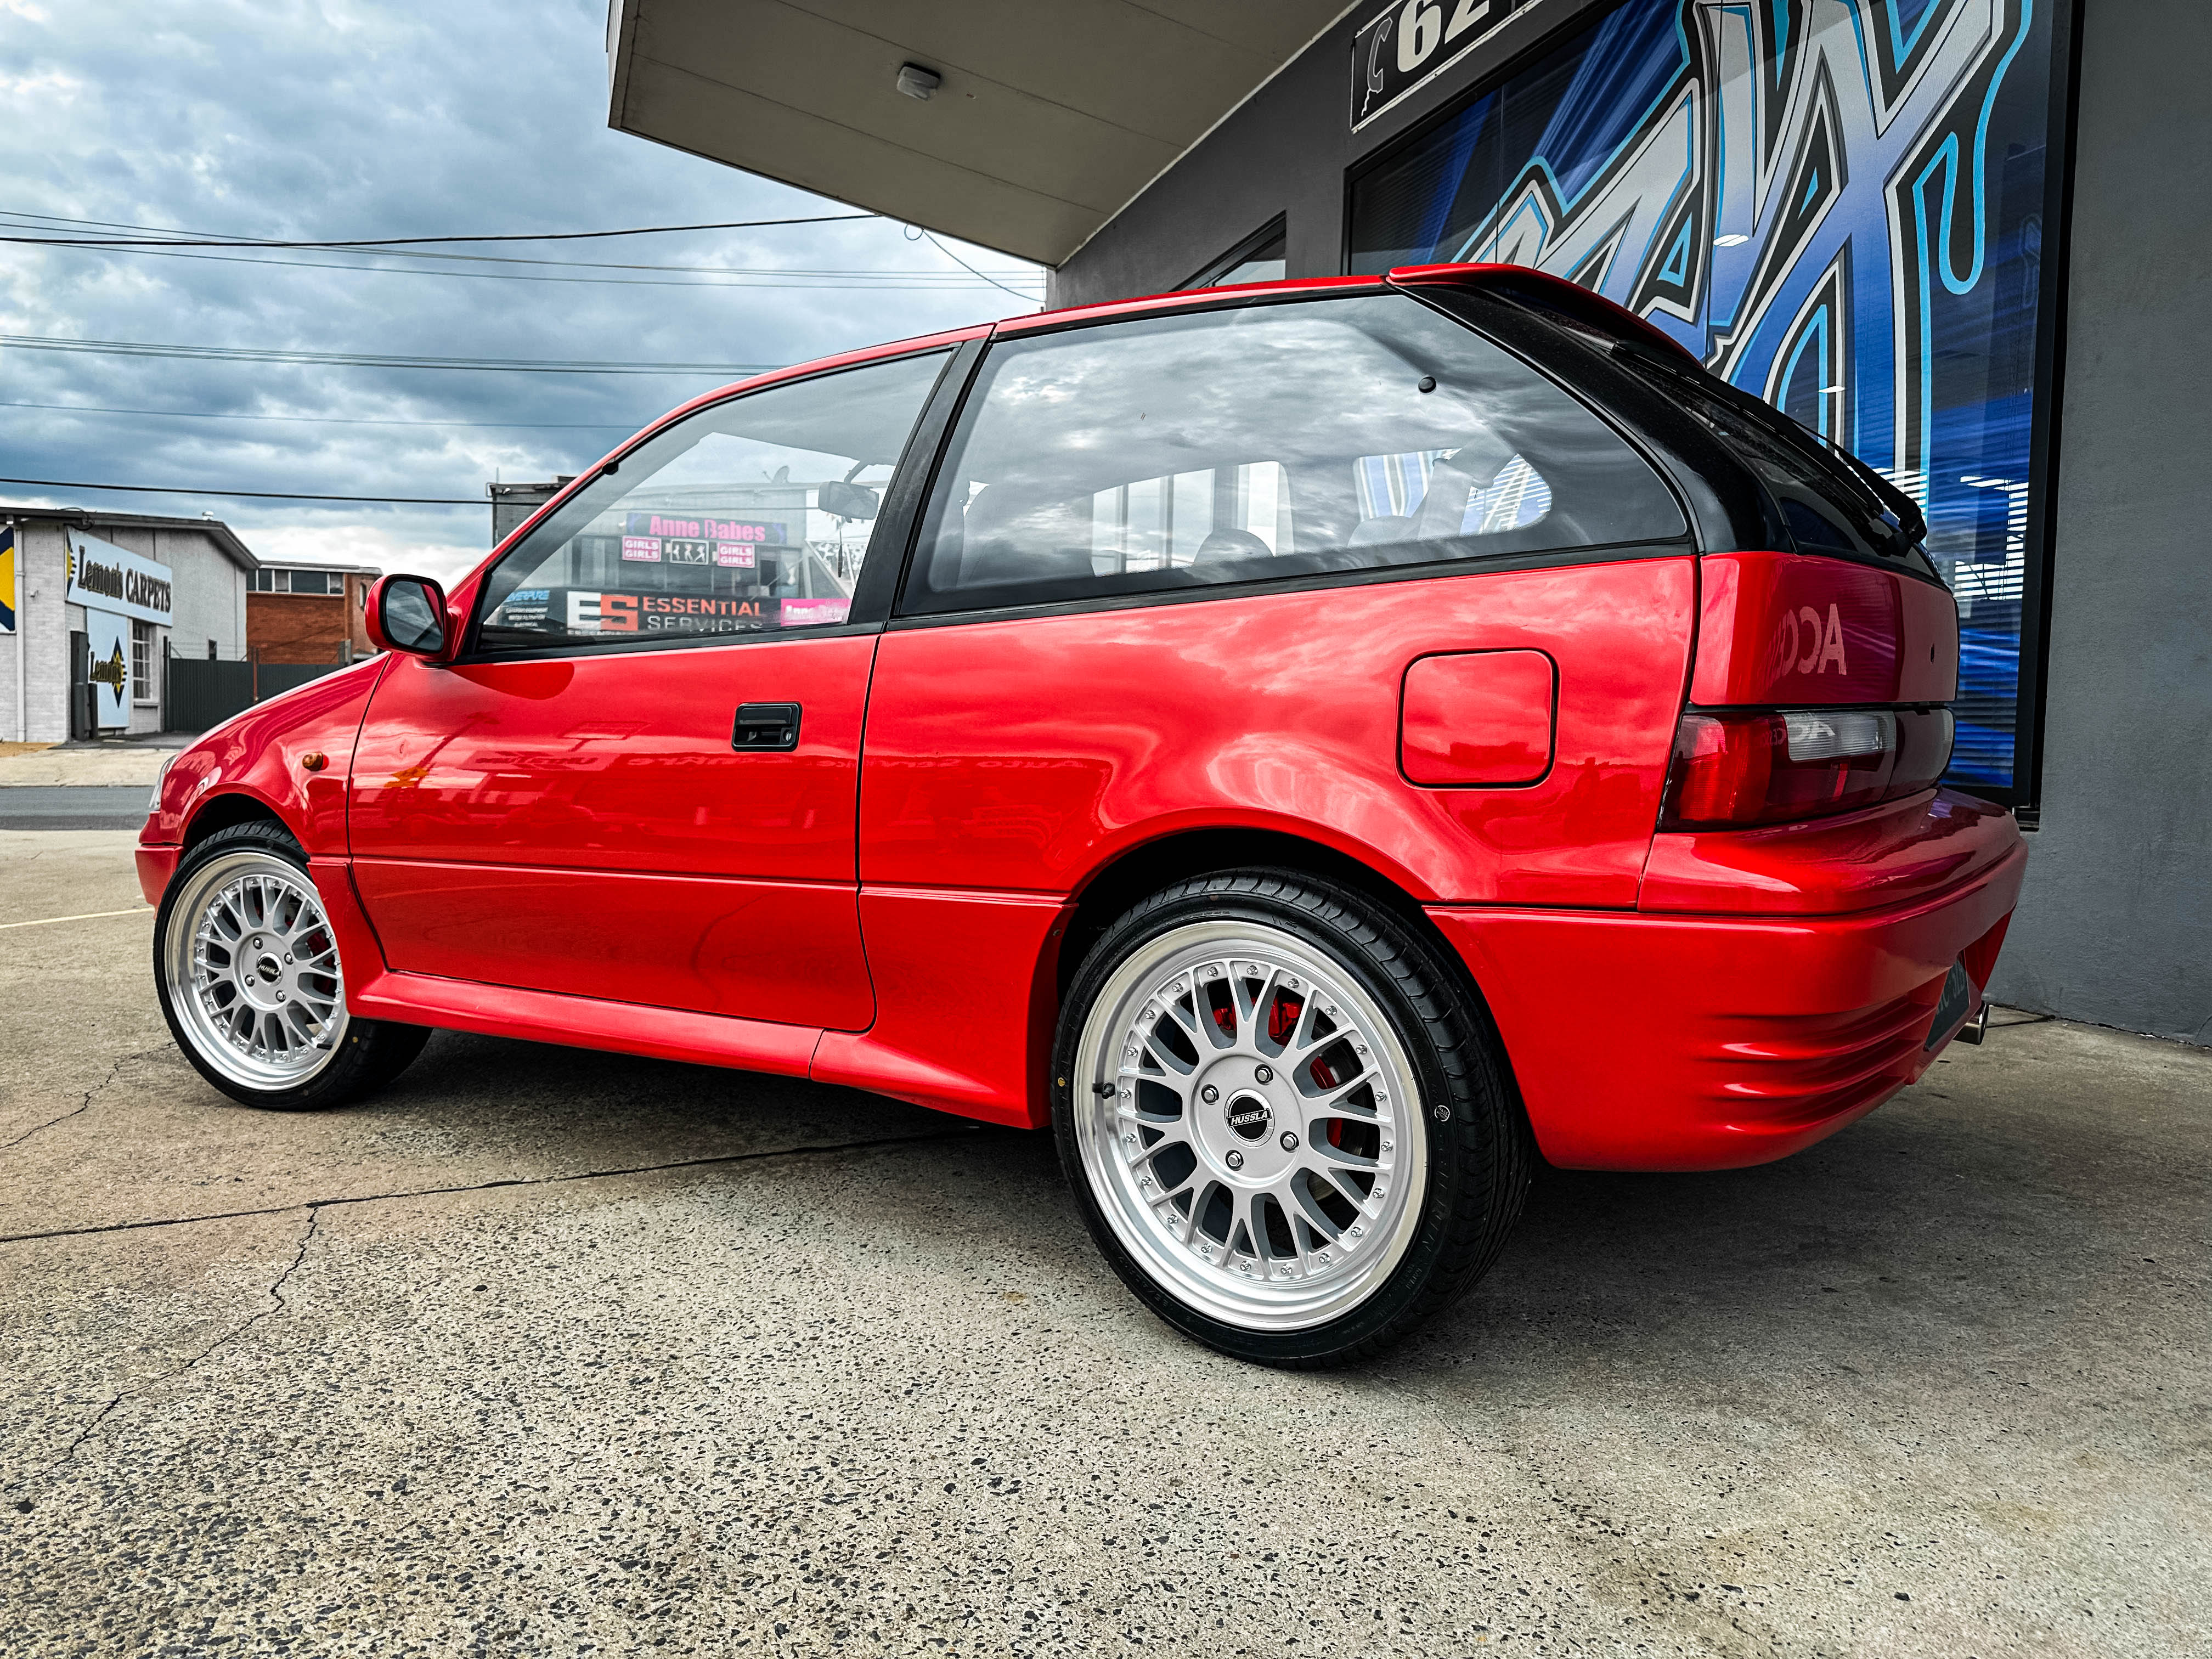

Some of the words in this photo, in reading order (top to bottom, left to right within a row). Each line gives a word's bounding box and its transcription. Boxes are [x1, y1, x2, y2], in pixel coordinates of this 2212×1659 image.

[650, 515, 700, 538] Anne
[704, 519, 766, 542] Babes
[624, 540, 659, 550] GIRLS
[719, 546, 752, 556] GIRLS
[624, 549, 658, 559] GIRLS
[720, 556, 752, 566] GIRLS
[126, 567, 171, 613] CARPETS
[643, 596, 763, 617] ESSENTIAL
[1231, 1110, 1268, 1125] HUSSLA
